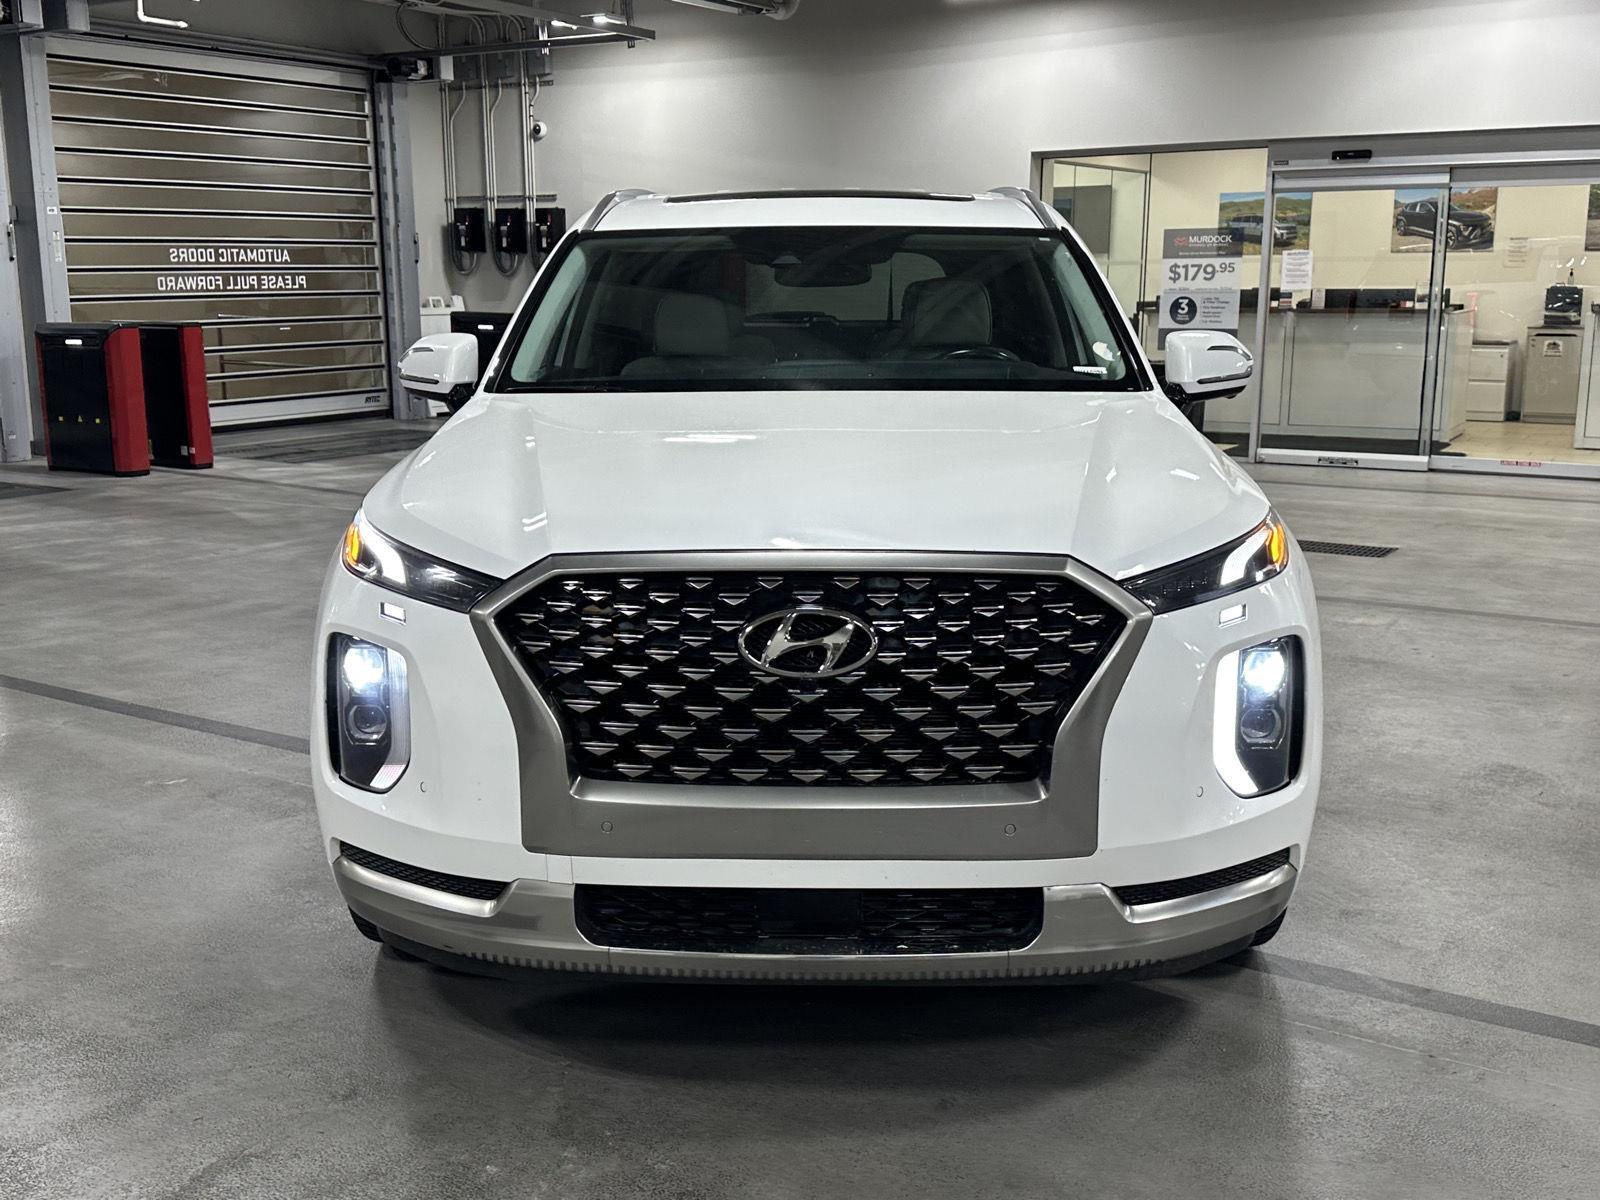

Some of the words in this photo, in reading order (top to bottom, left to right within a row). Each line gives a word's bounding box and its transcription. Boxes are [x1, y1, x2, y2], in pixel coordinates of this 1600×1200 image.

[1189, 235, 1232, 243] MURDOCK
[1169, 262, 1235, 283] $179.95
[1178, 299, 1189, 314] 3
